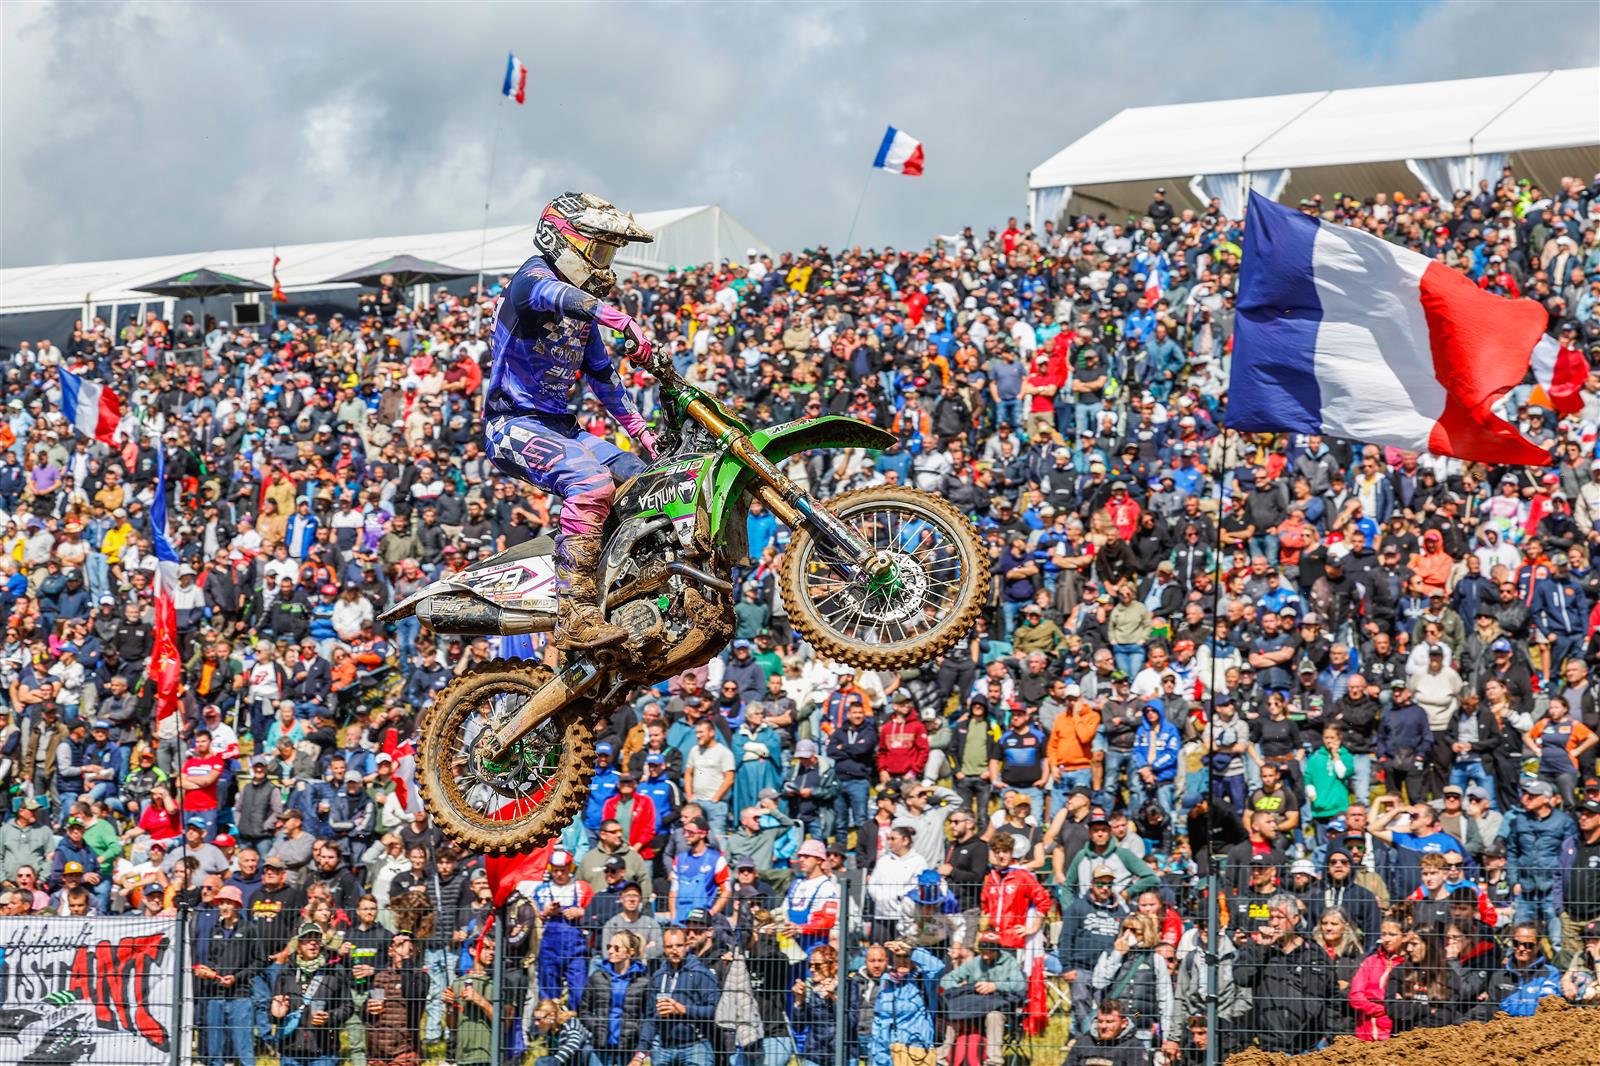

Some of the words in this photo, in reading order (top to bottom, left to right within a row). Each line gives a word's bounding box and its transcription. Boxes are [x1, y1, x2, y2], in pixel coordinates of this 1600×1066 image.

[638, 484, 677, 511] VENUM
[441, 602, 462, 612] HGS
[1255, 796, 1282, 810] 46
[0, 932, 170, 1053] ISTANT
